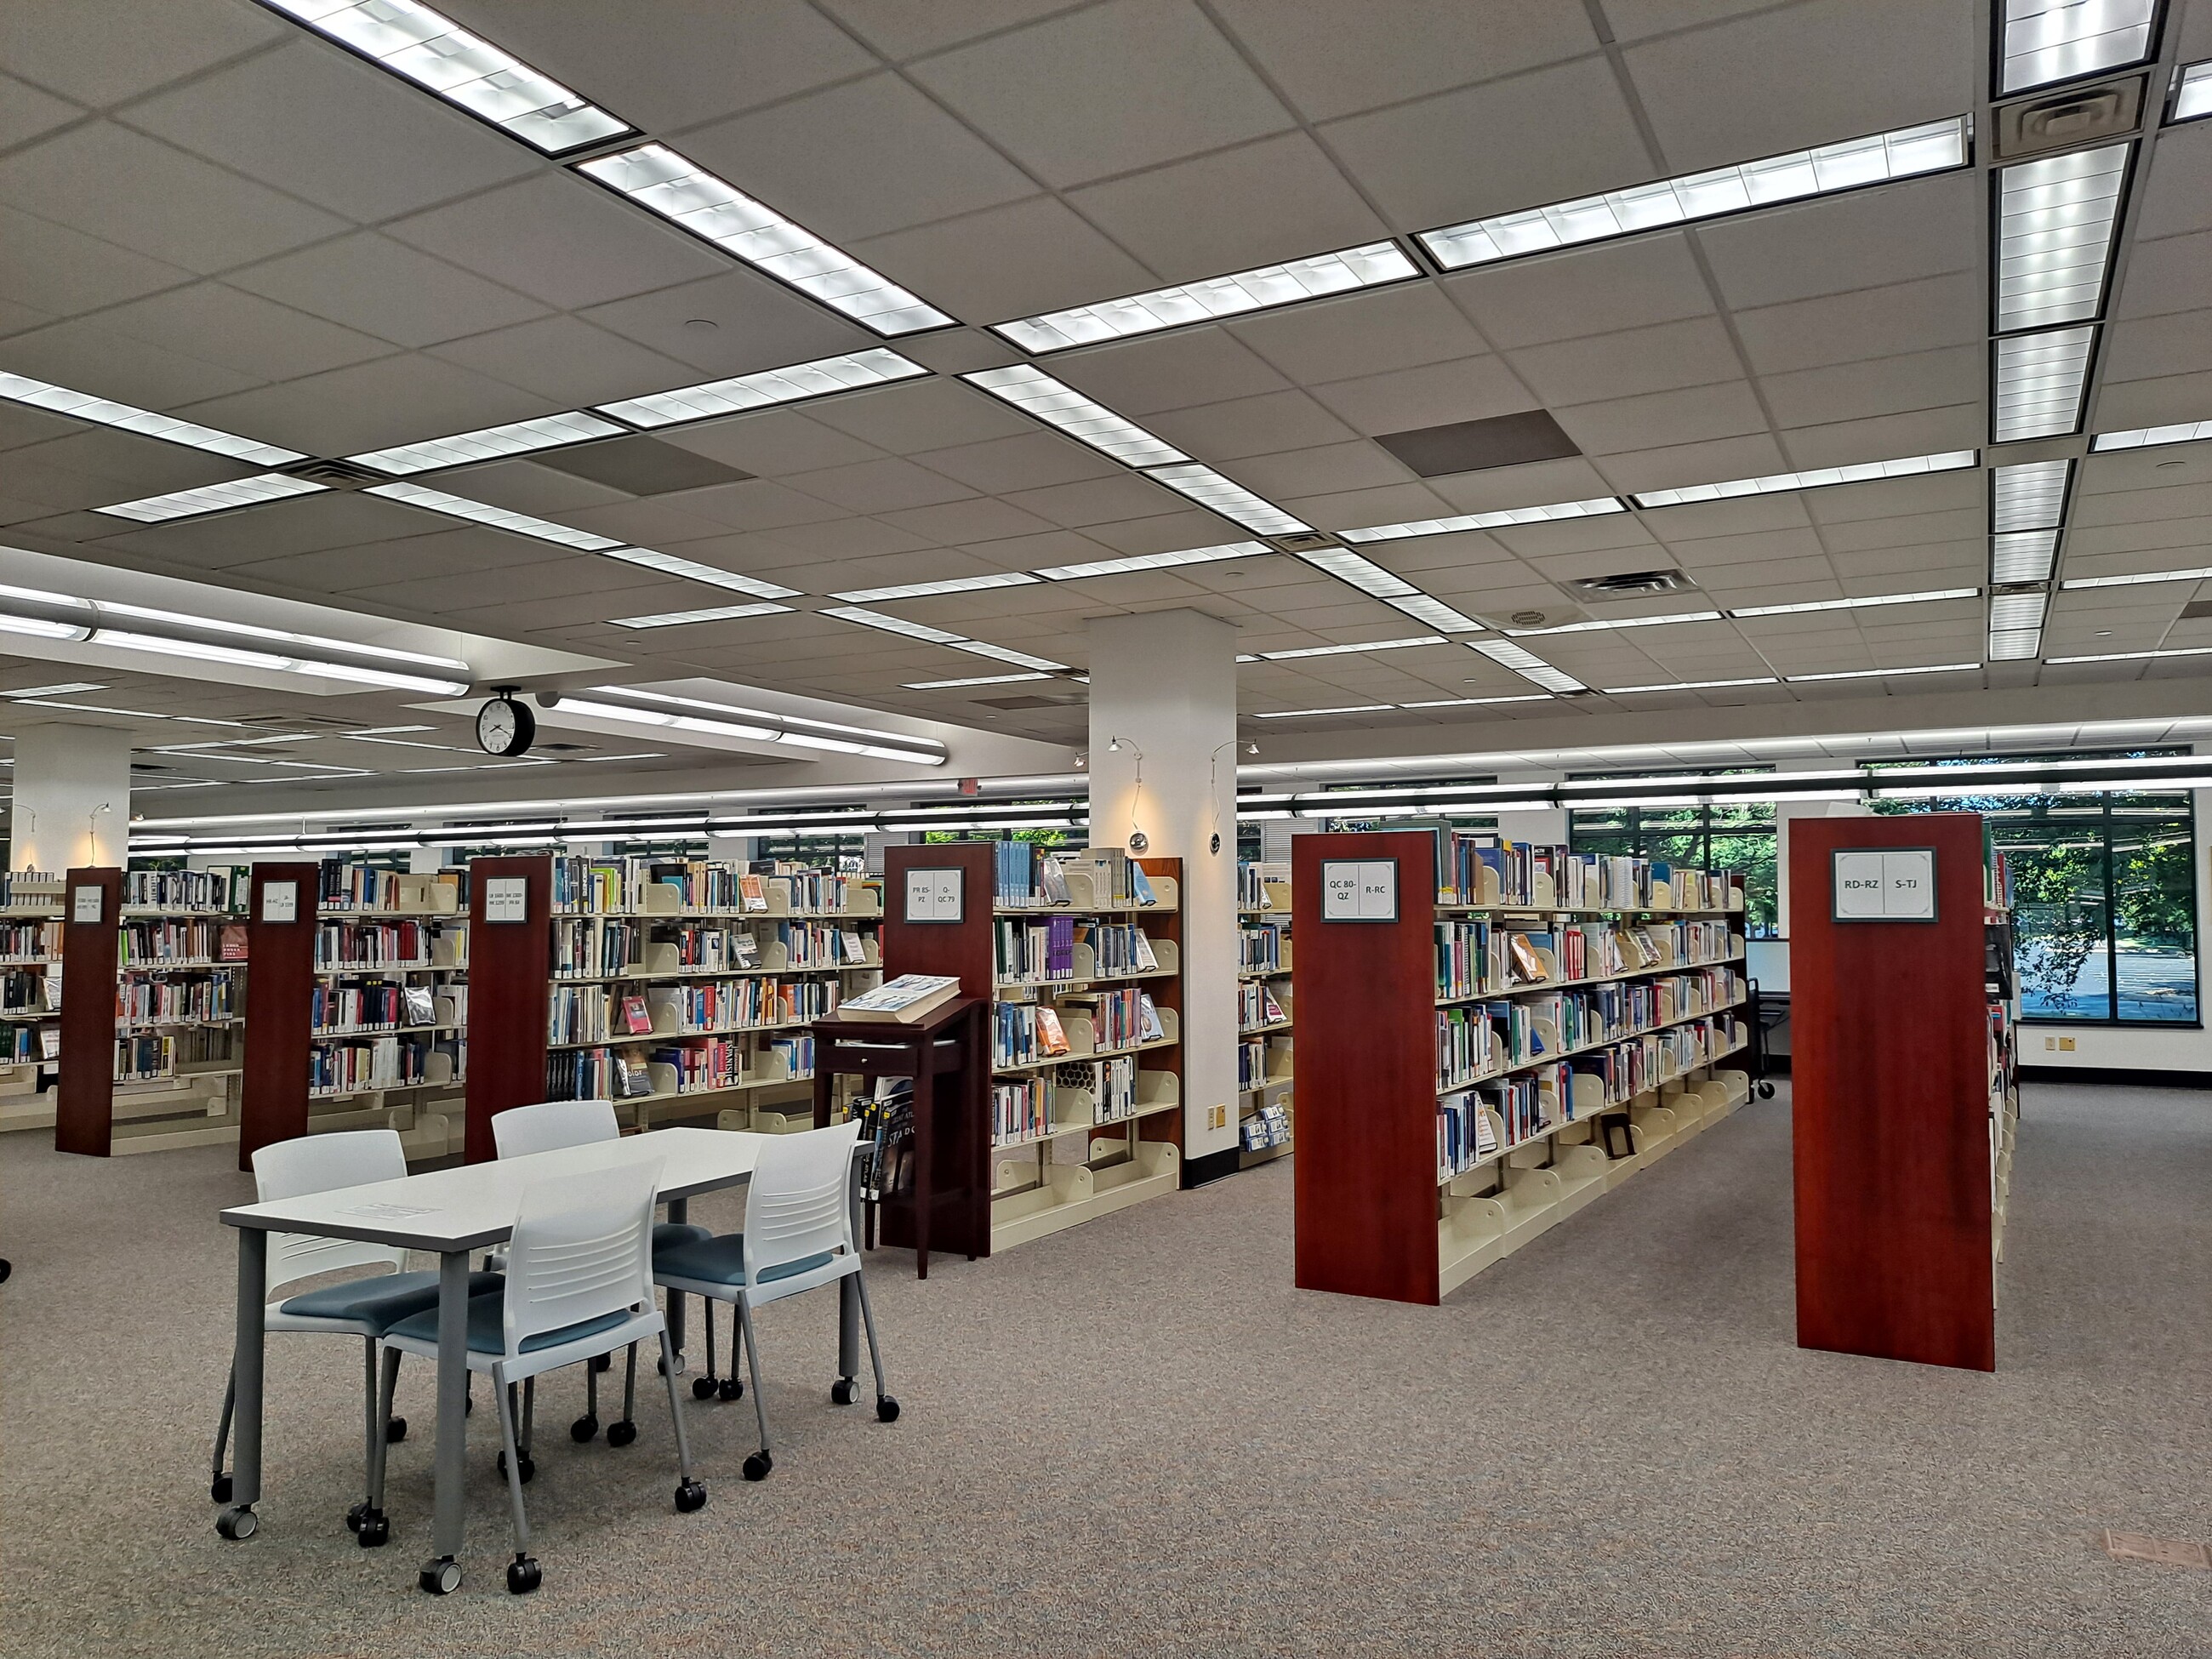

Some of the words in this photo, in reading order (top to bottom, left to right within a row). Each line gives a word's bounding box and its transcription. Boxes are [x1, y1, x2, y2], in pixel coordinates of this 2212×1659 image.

[1329, 880, 1342, 889] QC
[1343, 880, 1357, 888] 80-
[1844, 880, 1879, 889] RD-RZ
[1895, 879, 1917, 889] S-TJ
[1337, 892, 1349, 901] QZ
